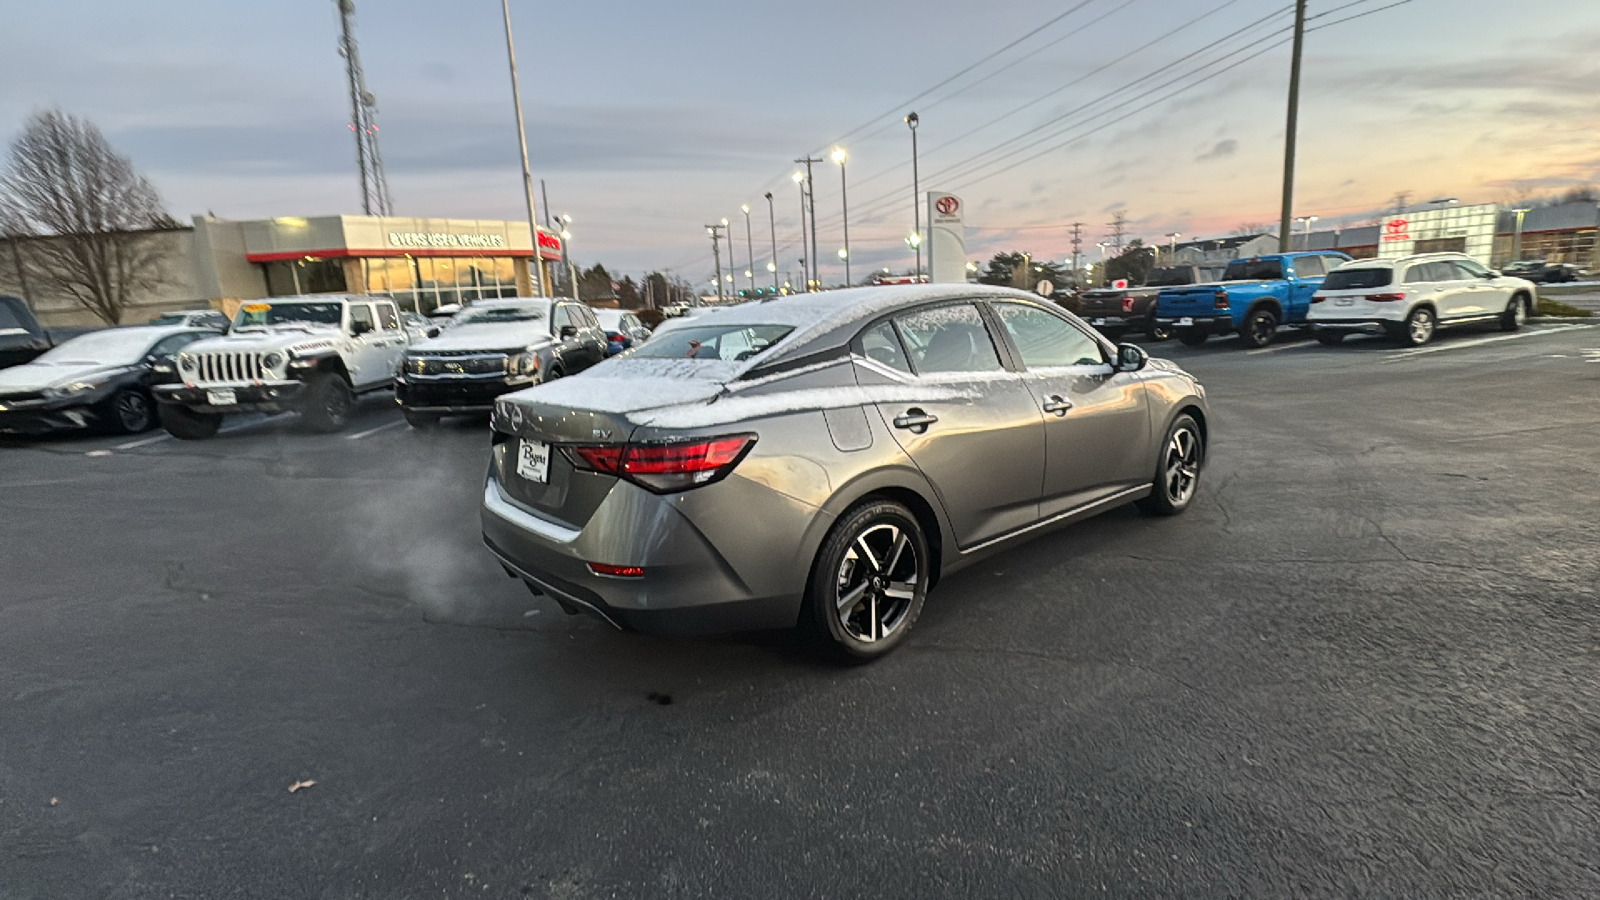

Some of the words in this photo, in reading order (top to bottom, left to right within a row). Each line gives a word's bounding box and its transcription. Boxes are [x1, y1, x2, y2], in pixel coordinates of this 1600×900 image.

[390, 233, 427, 246] BYERS
[427, 233, 457, 246] USED
[457, 234, 504, 247] VEHICLES
